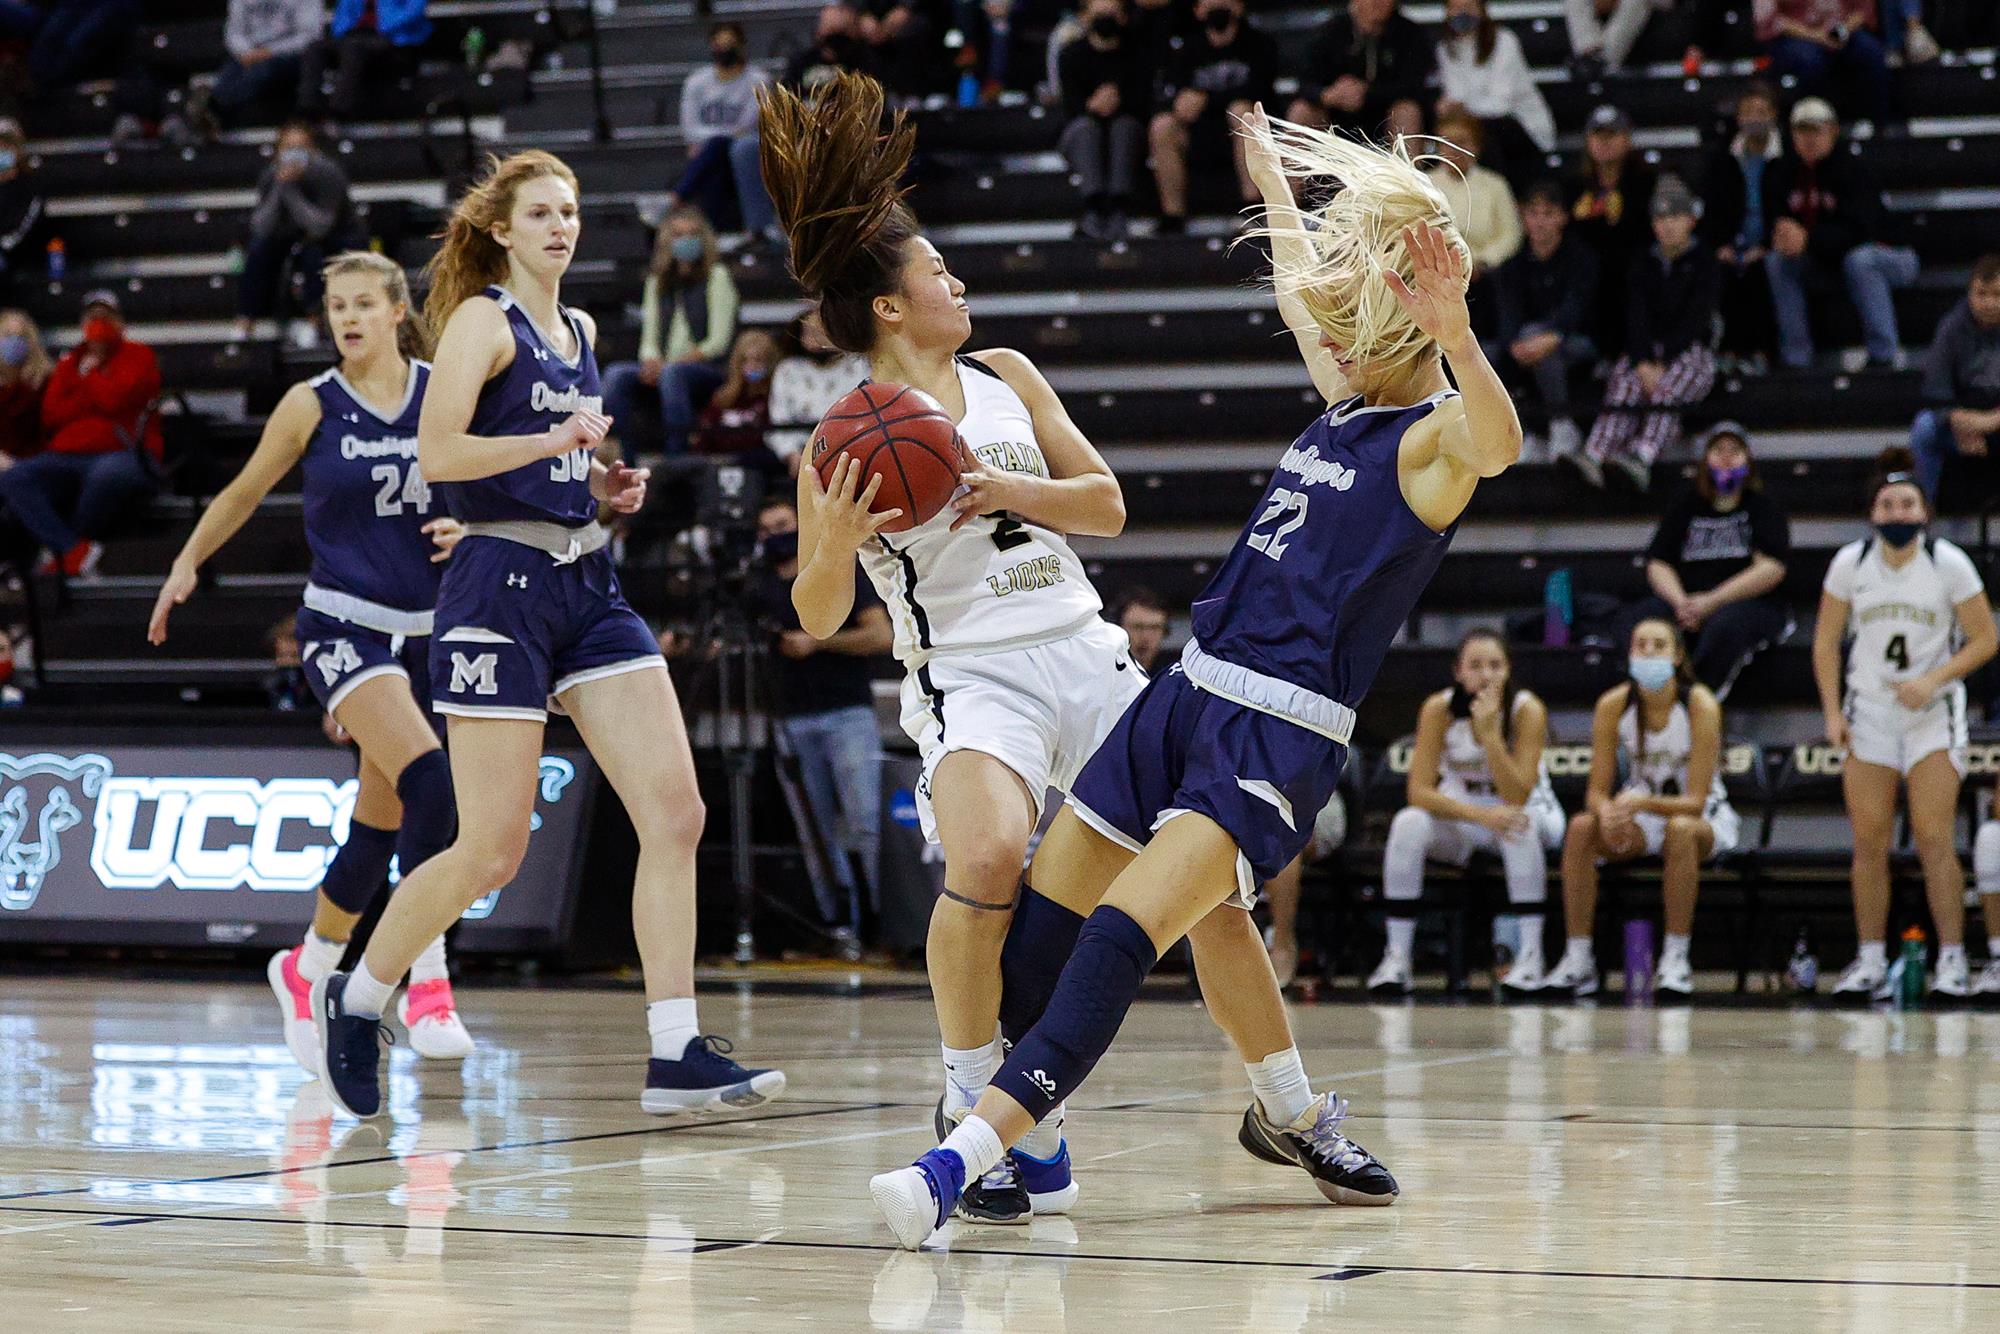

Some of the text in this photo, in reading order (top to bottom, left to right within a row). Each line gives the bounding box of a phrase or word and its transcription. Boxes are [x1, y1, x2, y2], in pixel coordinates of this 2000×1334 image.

[371, 461, 432, 517] 24
[1246, 487, 1309, 561] 22
[986, 554, 1066, 598] LIONS
[315, 637, 364, 688] M
[449, 651, 499, 695] M
[1885, 632, 1910, 671] 4
[89, 776, 361, 892] UCC
